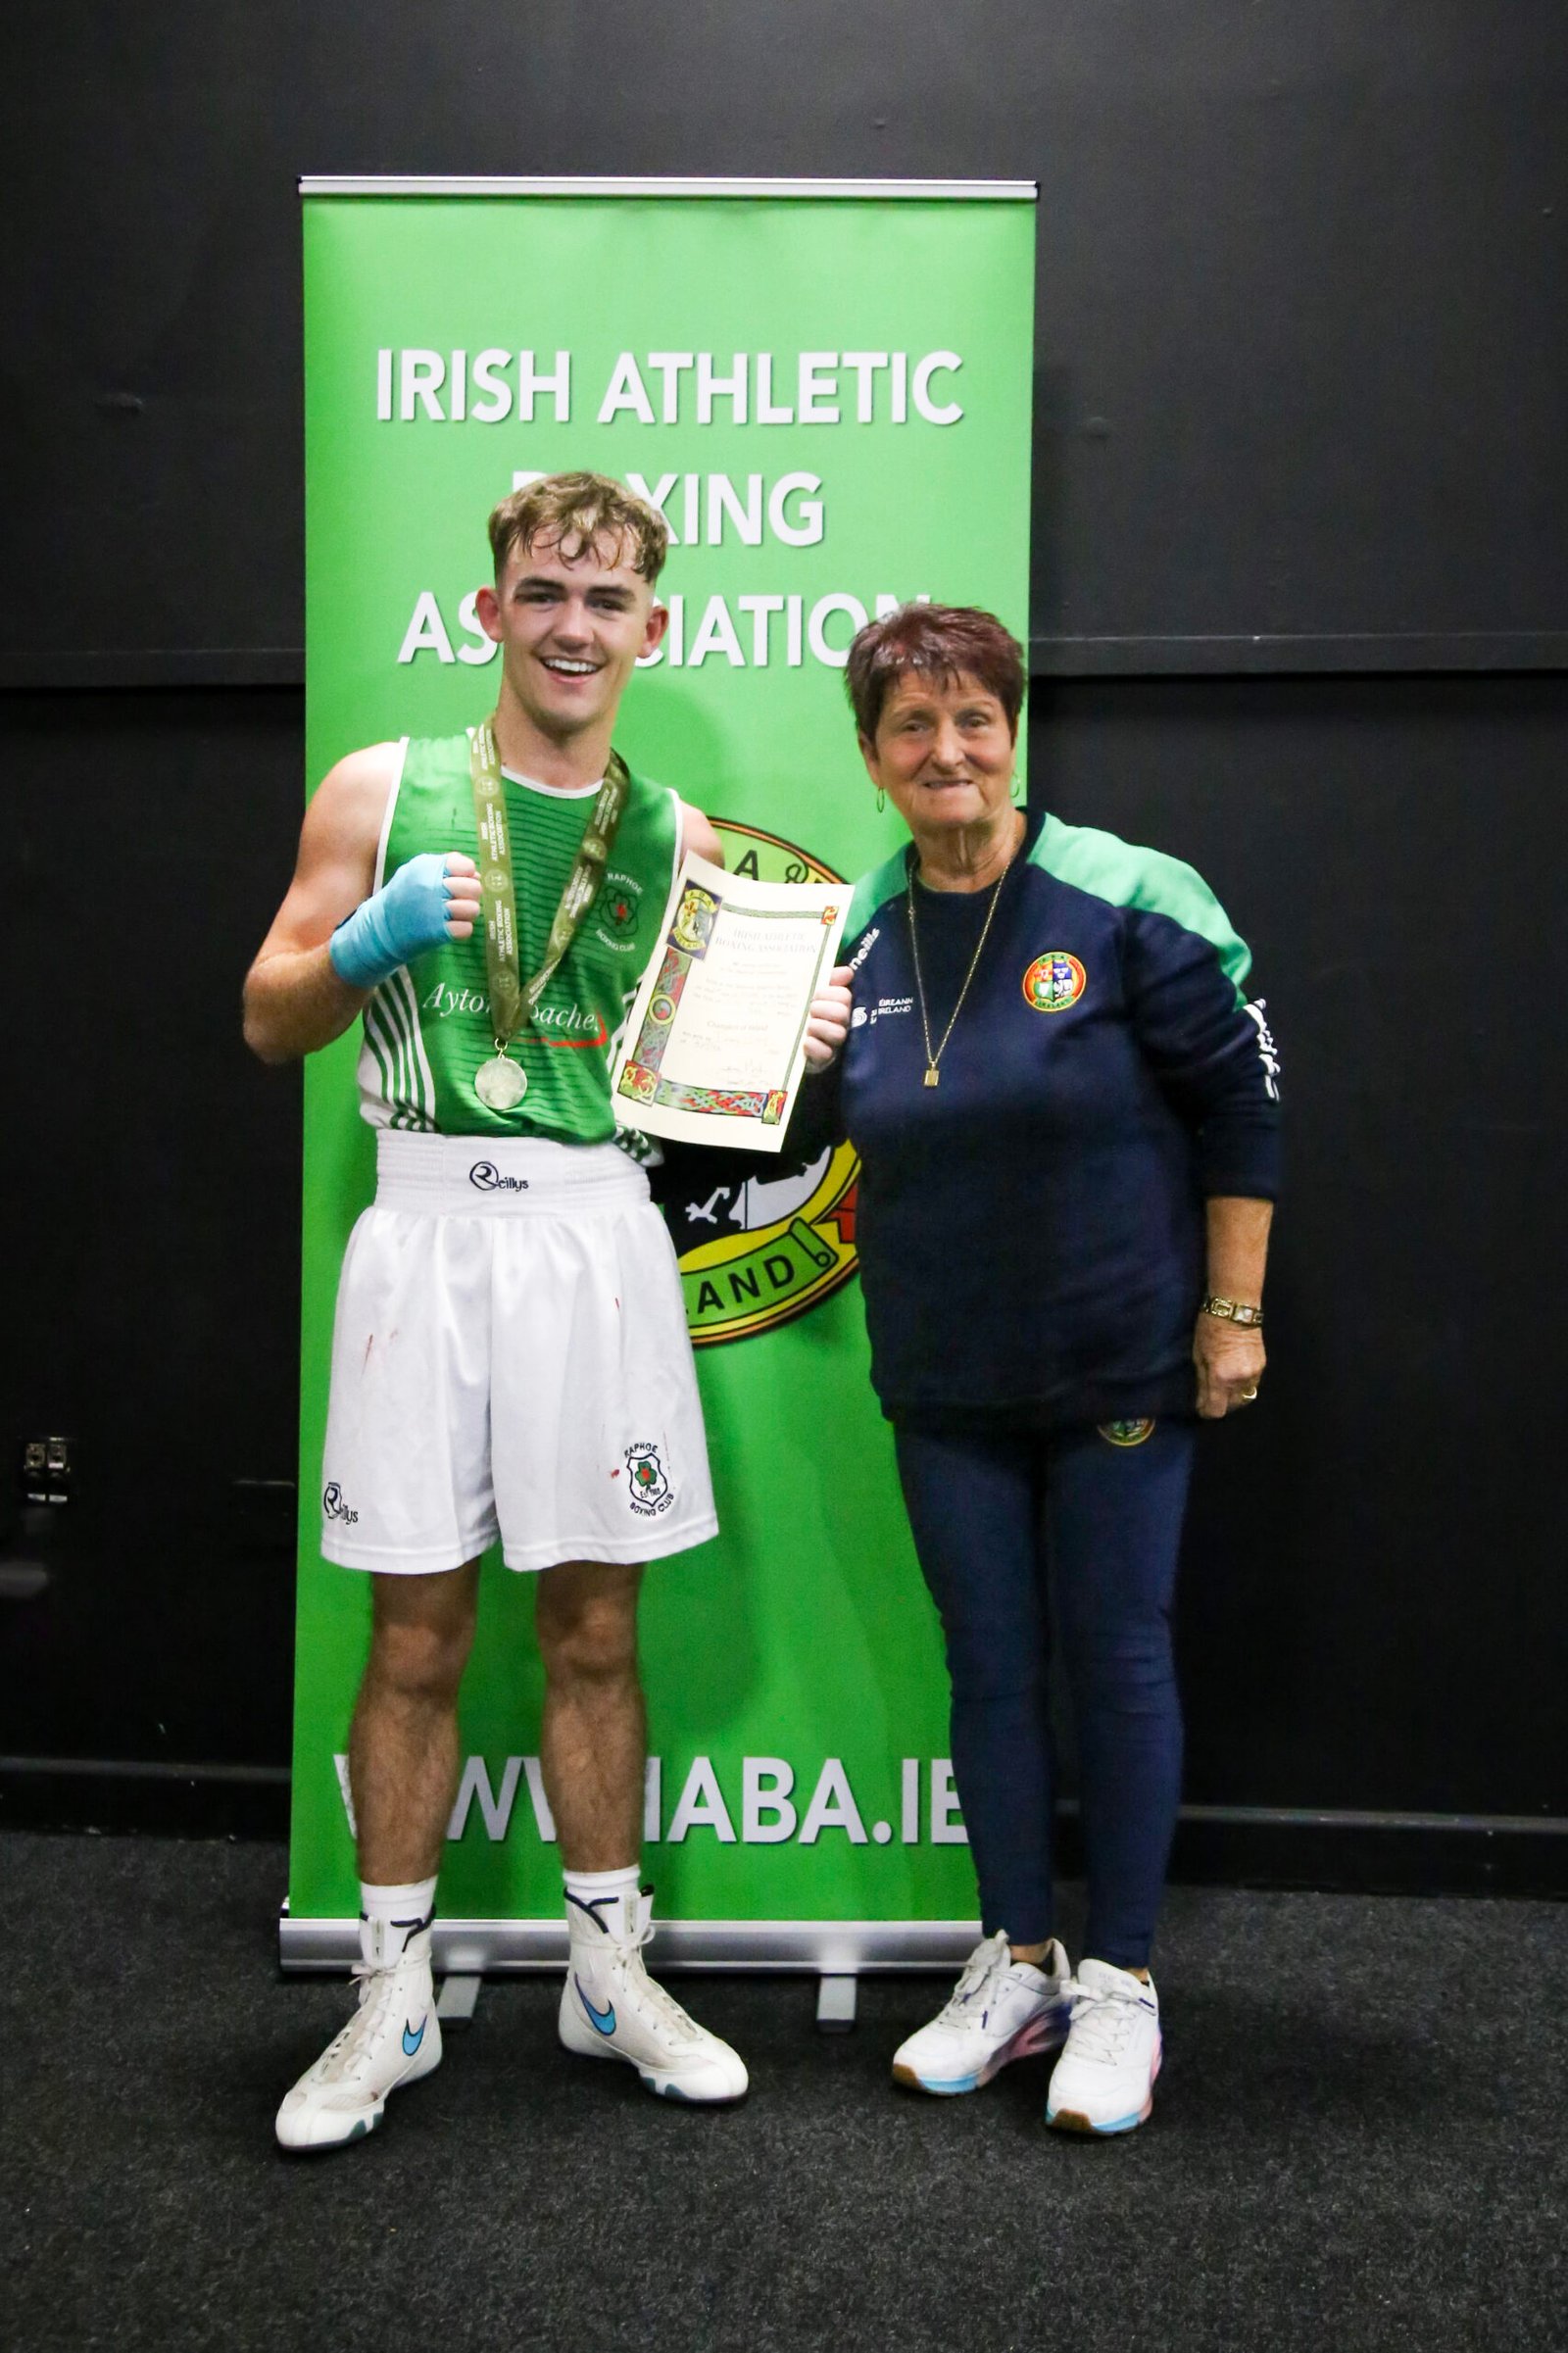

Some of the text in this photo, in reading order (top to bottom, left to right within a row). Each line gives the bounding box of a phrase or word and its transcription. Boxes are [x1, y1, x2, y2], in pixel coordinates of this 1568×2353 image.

[378, 348, 963, 424] IRISH ATHLETIC
[512, 470, 823, 547] XING
[422, 982, 490, 1017] Ayto
